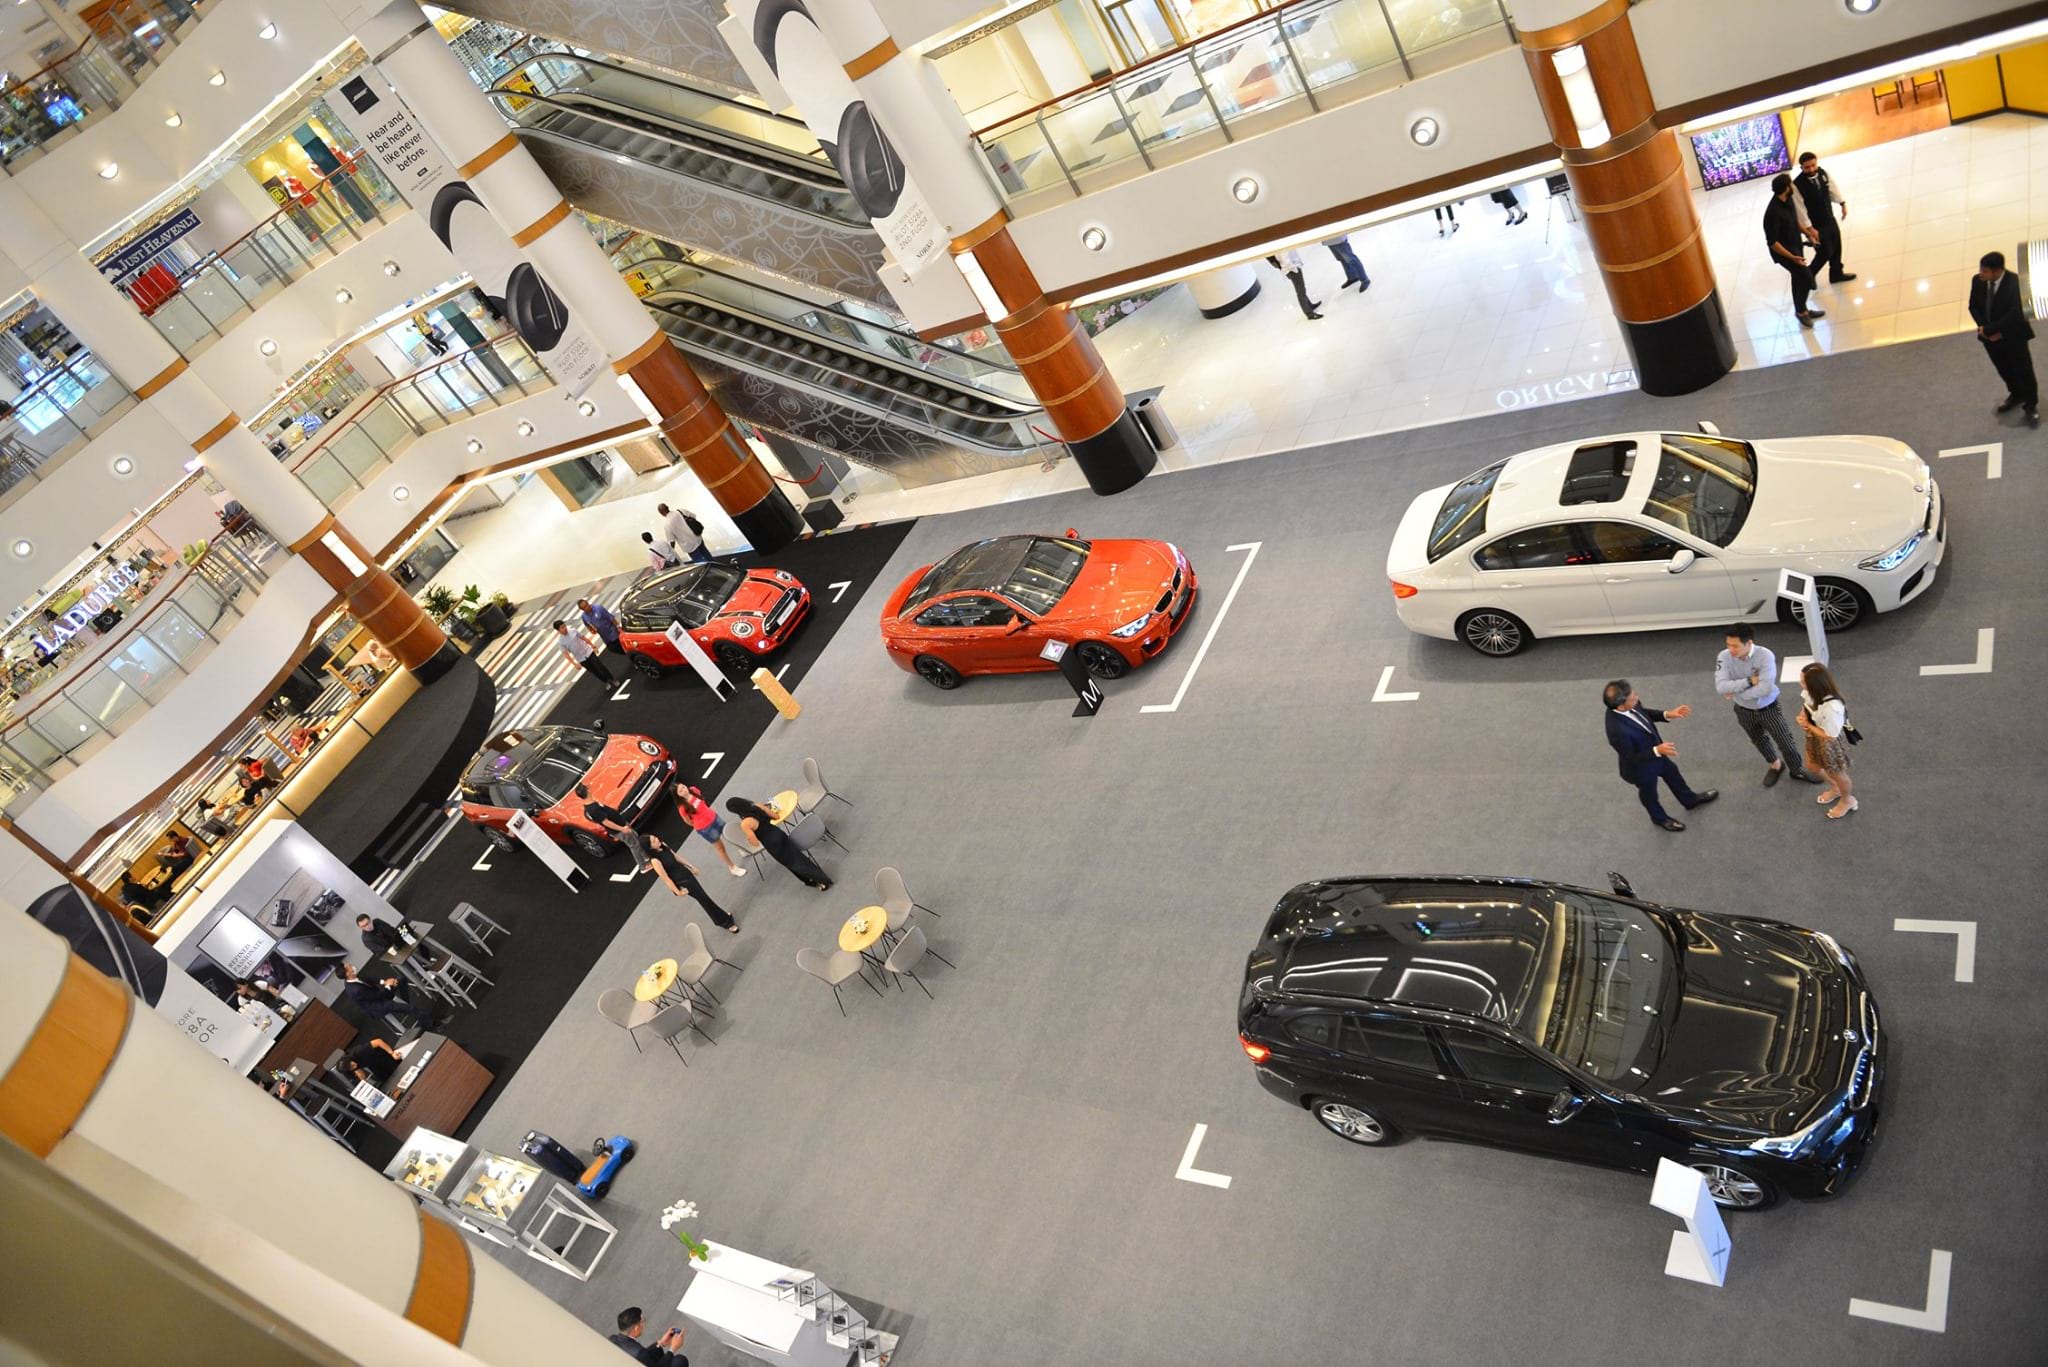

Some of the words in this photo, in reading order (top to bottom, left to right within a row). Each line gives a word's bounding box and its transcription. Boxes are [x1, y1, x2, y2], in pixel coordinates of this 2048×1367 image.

[366, 123, 389, 143] Hear
[388, 112, 405, 129] and
[375, 141, 390, 154] be
[387, 122, 413, 146] heard
[382, 148, 400, 165] like
[399, 133, 422, 154] never
[396, 148, 428, 172] before.
[118, 248, 146, 272] JUST
[141, 214, 197, 255] HEAVENLY
[1081, 678, 1101, 709] M
[178, 1007, 196, 1026] ORE
[185, 1016, 208, 1034] 8A
